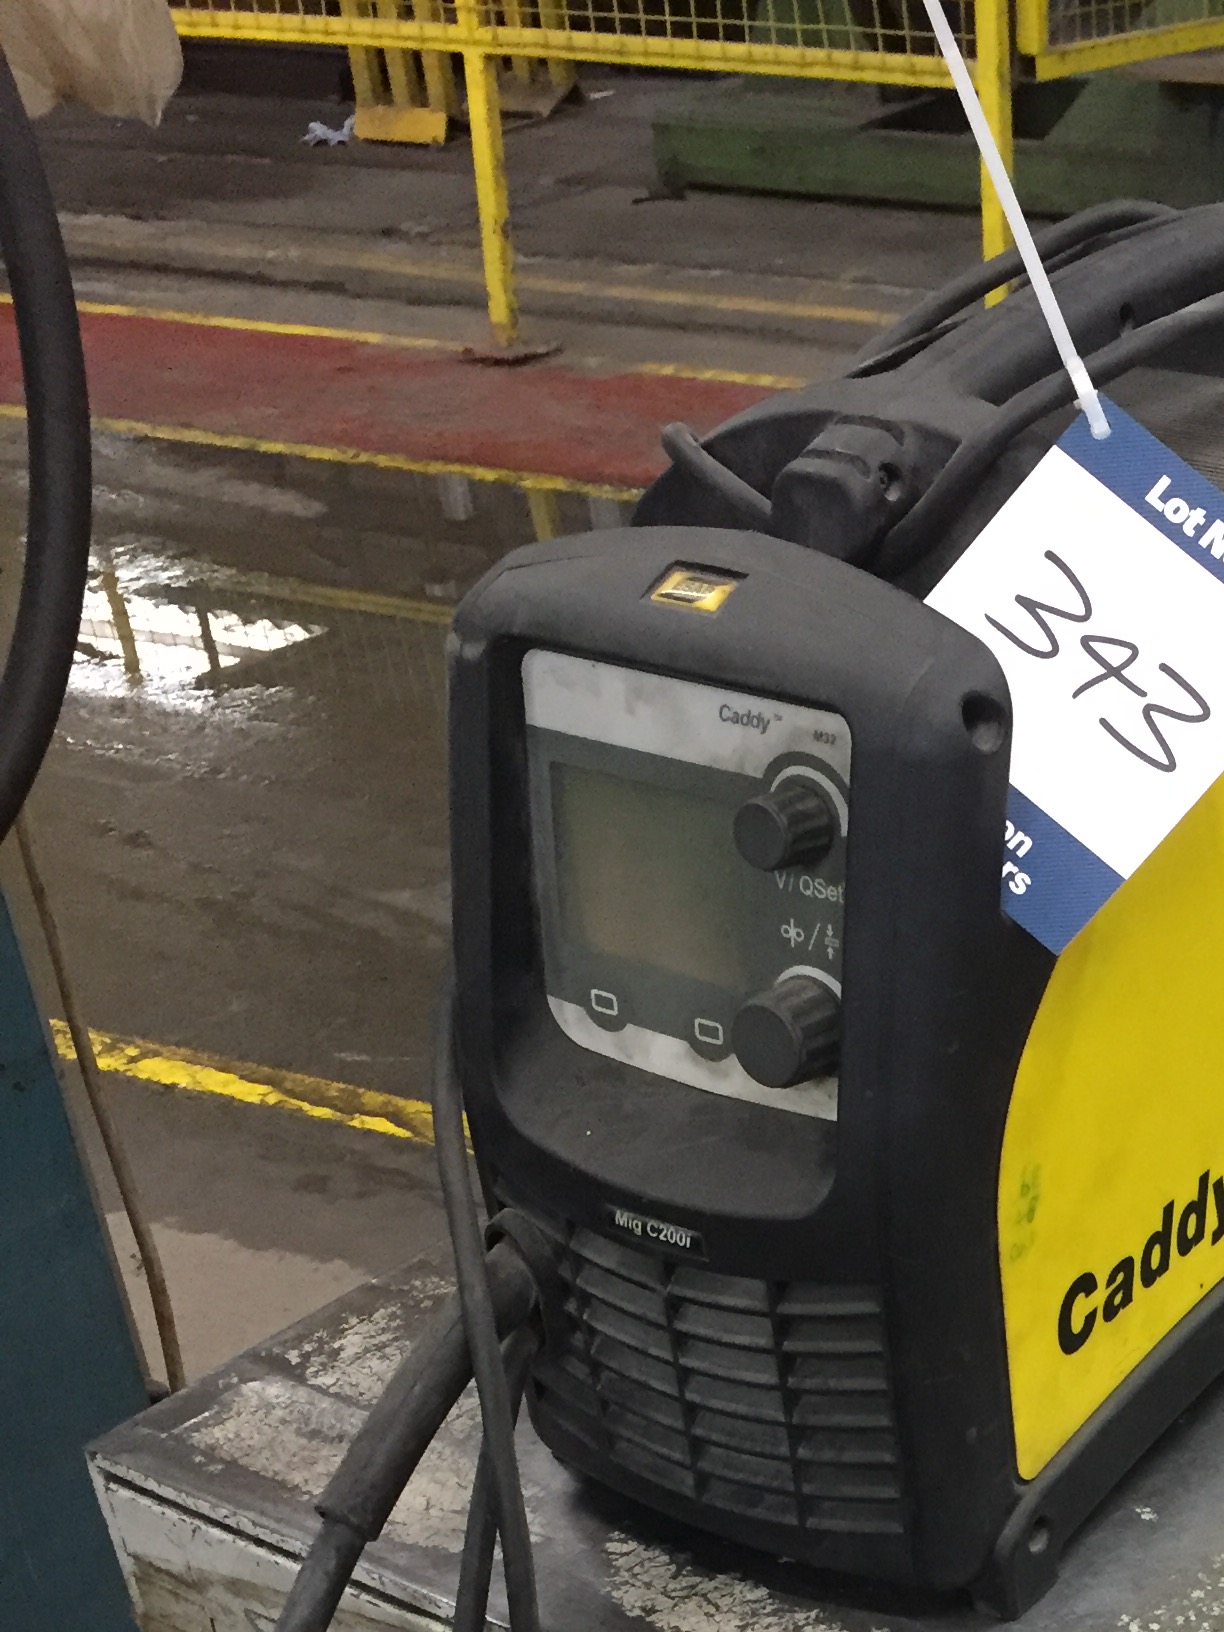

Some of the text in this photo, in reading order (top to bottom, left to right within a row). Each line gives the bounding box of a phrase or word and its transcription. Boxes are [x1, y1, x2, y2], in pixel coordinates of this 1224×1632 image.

[1144, 474, 1207, 538] Lot
[984, 549, 1211, 773] 343
[614, 1208, 692, 1249] Mig C200i
